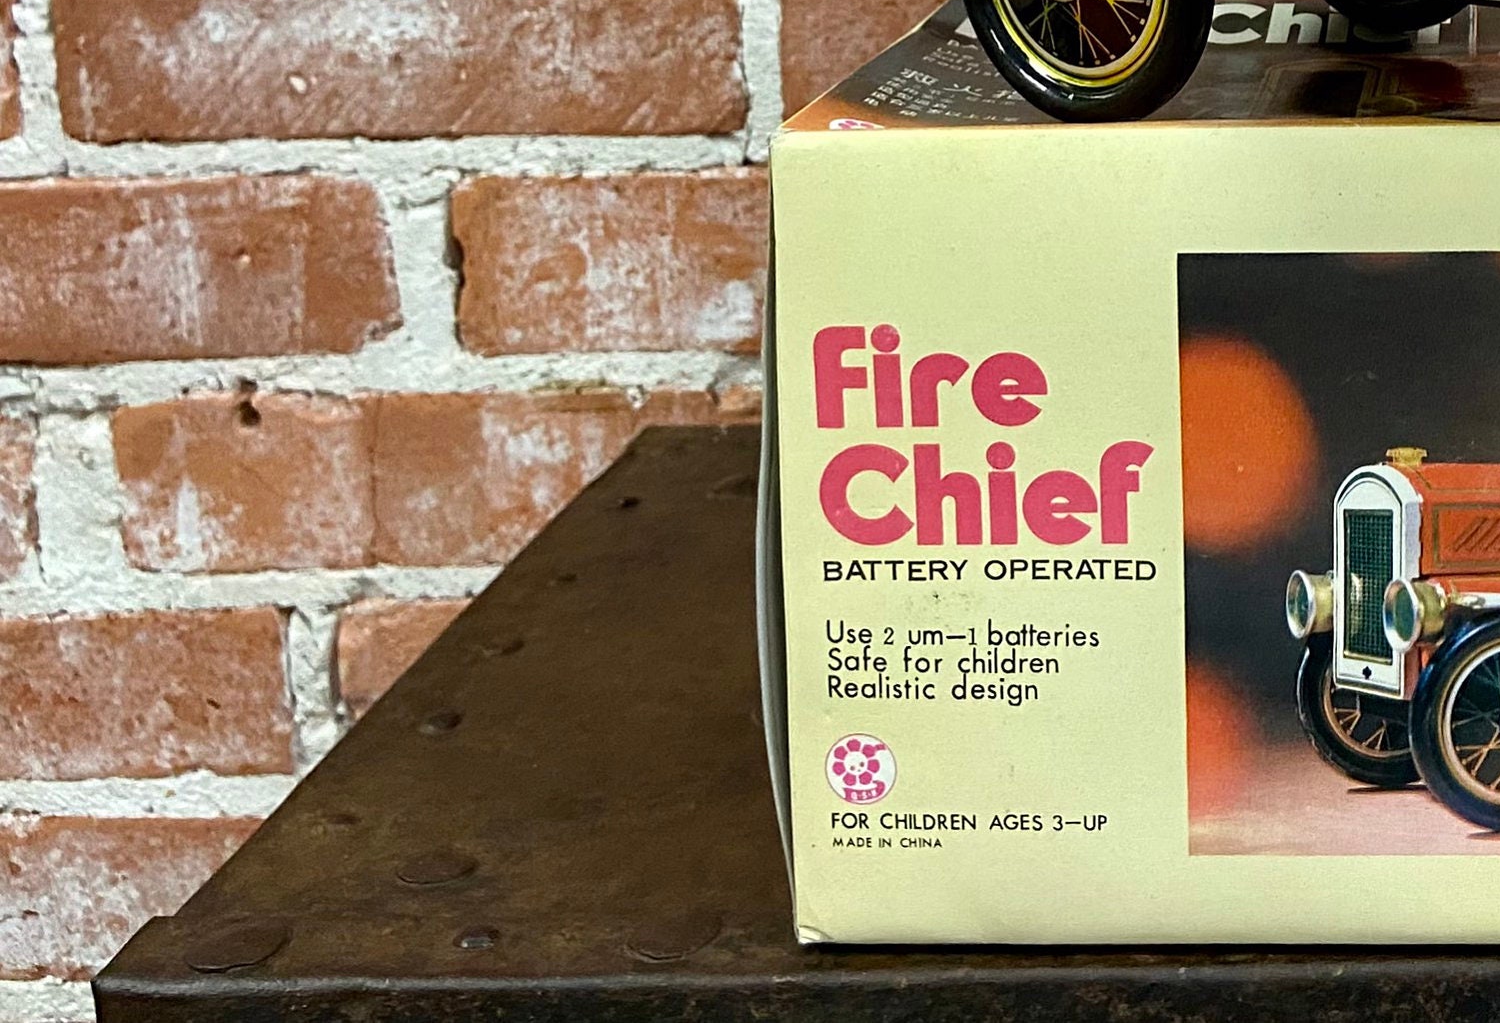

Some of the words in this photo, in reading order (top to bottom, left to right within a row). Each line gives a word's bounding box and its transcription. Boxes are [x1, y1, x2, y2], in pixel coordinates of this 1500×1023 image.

[813, 324, 1048, 428] Fire
[819, 440, 1154, 545] Chief
[823, 559, 968, 582] BATTERY
[984, 559, 1156, 581] OPERATED
[826, 619, 873, 644] Use
[883, 626, 895, 645] 2
[988, 618, 1100, 647] batteries
[828, 645, 888, 672] Safe
[903, 645, 943, 673] for
[957, 647, 1059, 674] children
[828, 673, 936, 700] Realistic
[951, 673, 1038, 706] design
[831, 812, 870, 830] FOR
[880, 812, 977, 831] CHILDREN
[989, 814, 1043, 831] AGES
[832, 836, 872, 848] MADE
[878, 837, 892, 848] IN
[900, 837, 942, 848] CHINA
